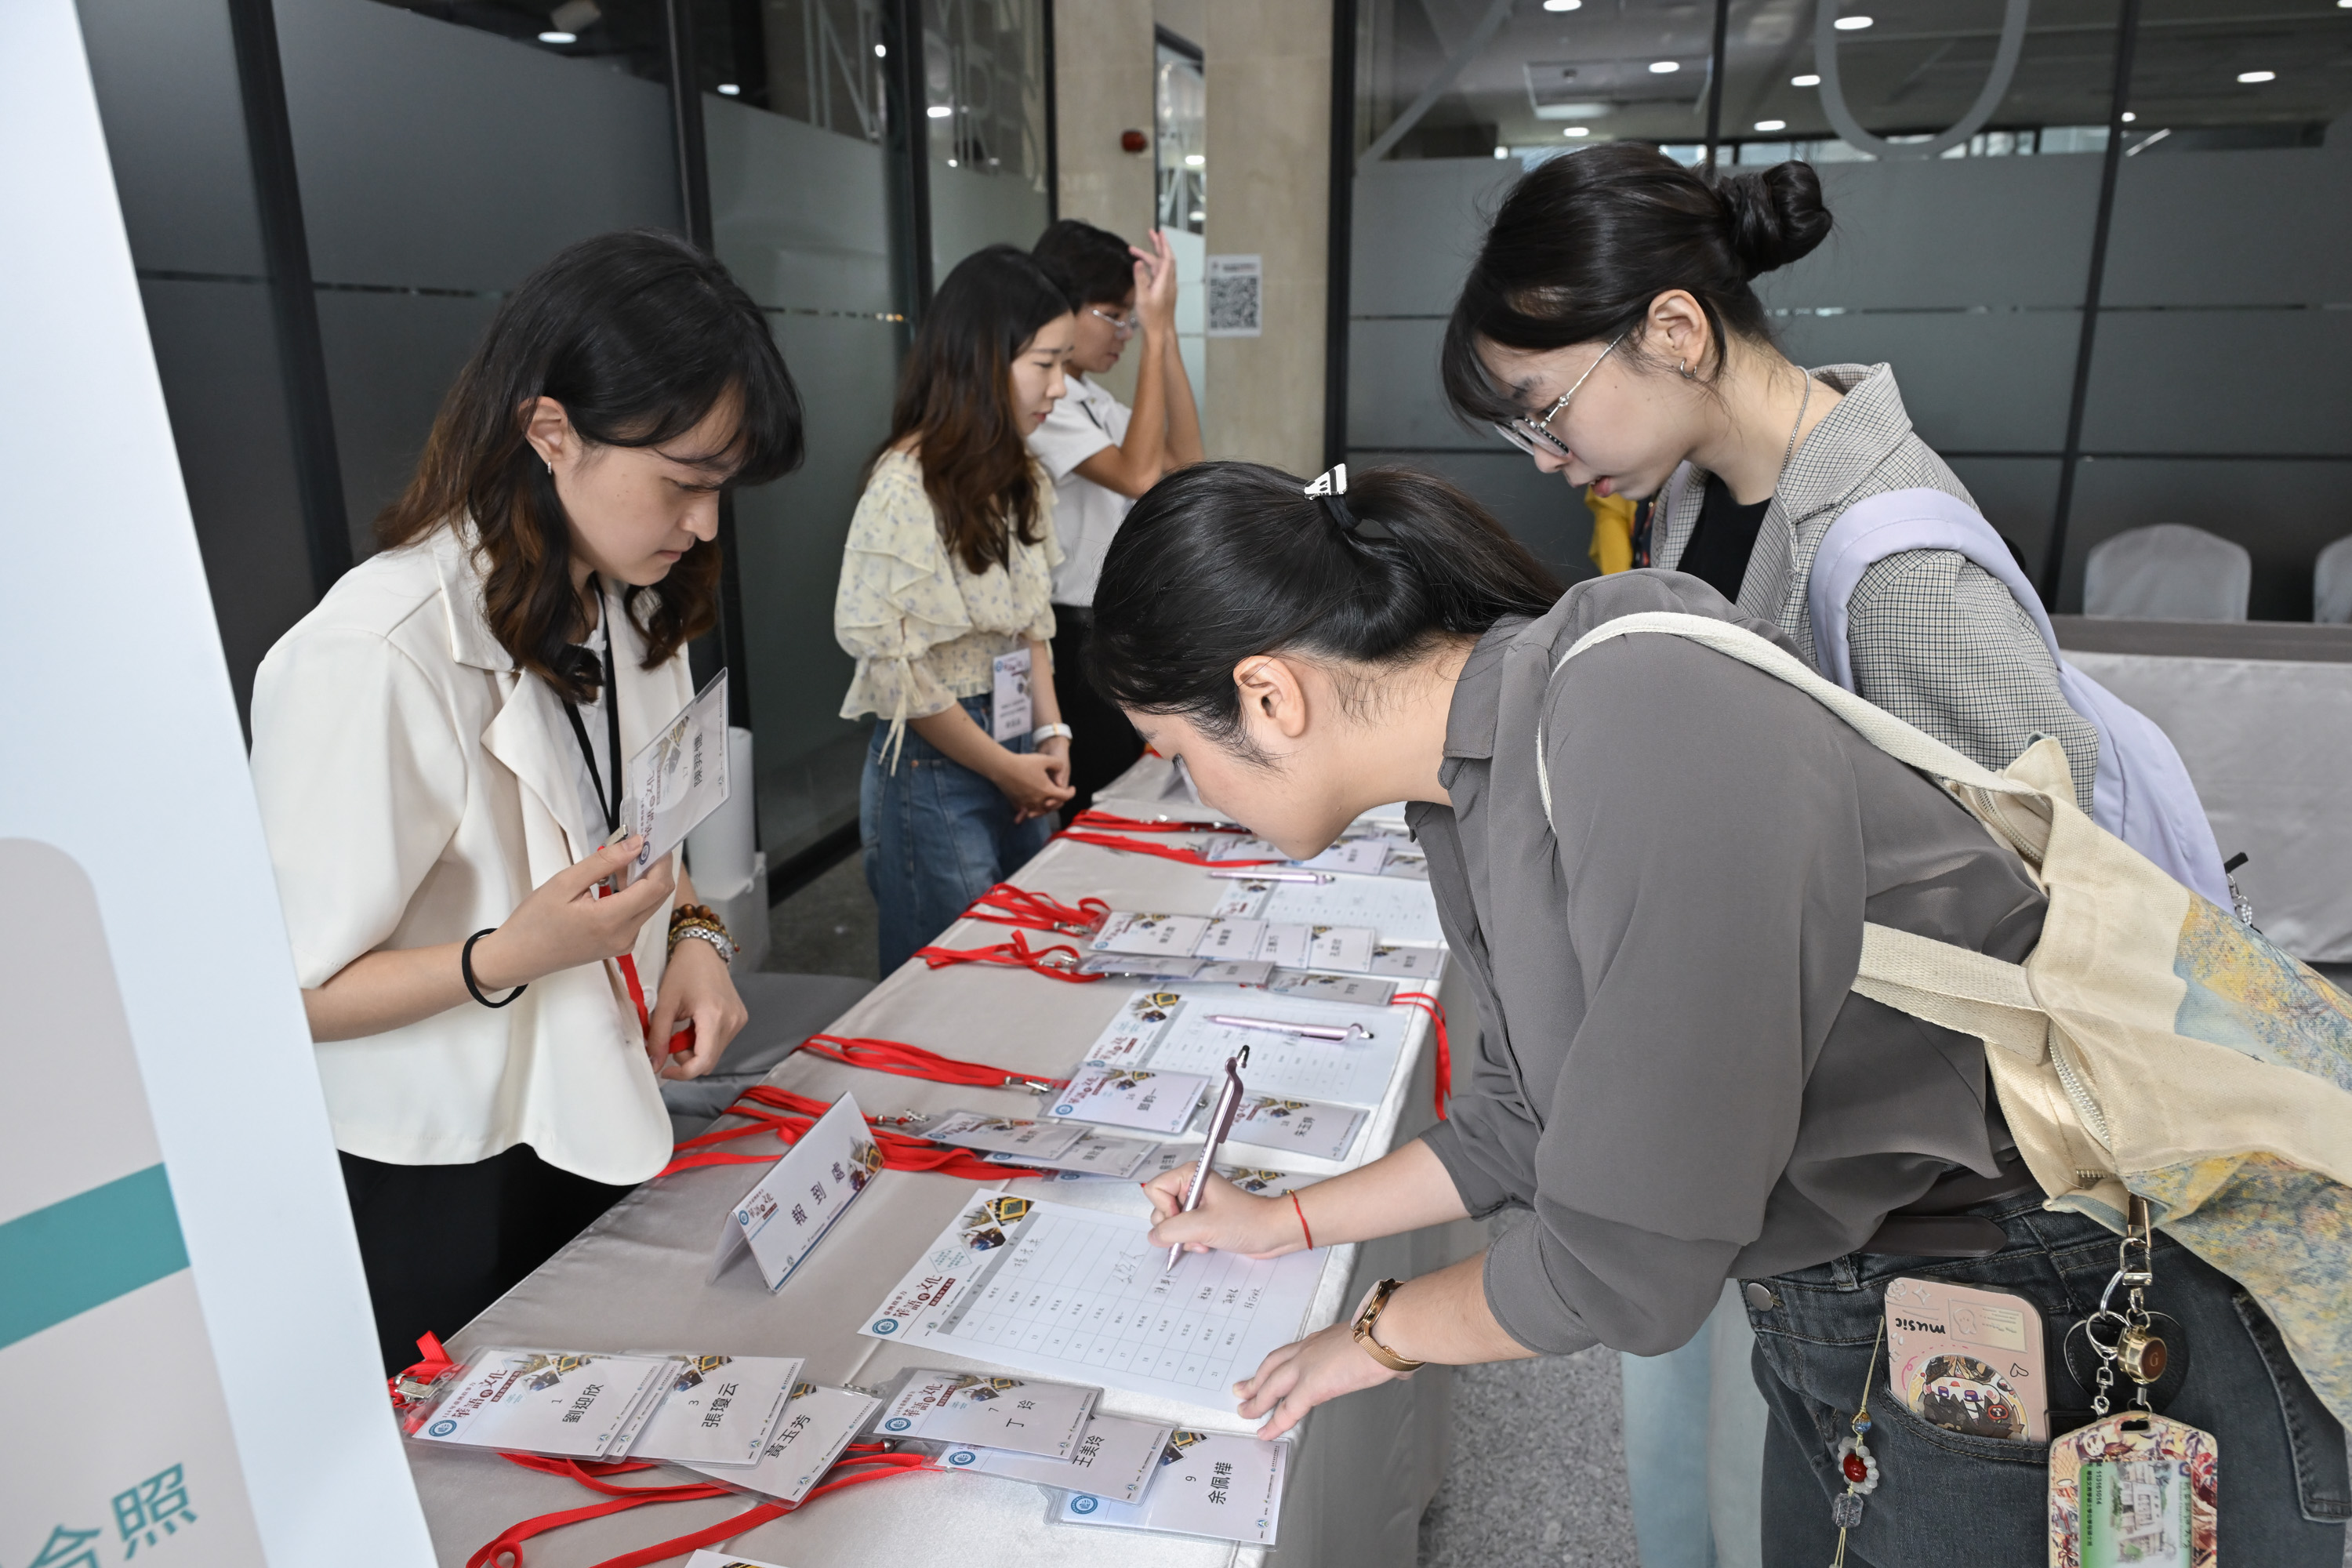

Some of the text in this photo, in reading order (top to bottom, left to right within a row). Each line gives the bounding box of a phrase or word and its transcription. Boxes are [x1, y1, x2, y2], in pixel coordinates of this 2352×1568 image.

[1896, 1318, 1946, 1334] music
[561, 1383, 604, 1423] 劉迎欣
[701, 1382, 739, 1428] 張瓊云
[764, 1414, 811, 1458] 黃玉芳
[1072, 1435, 1105, 1468] 王美玲
[1208, 1461, 1233, 1504] 余佩樺
